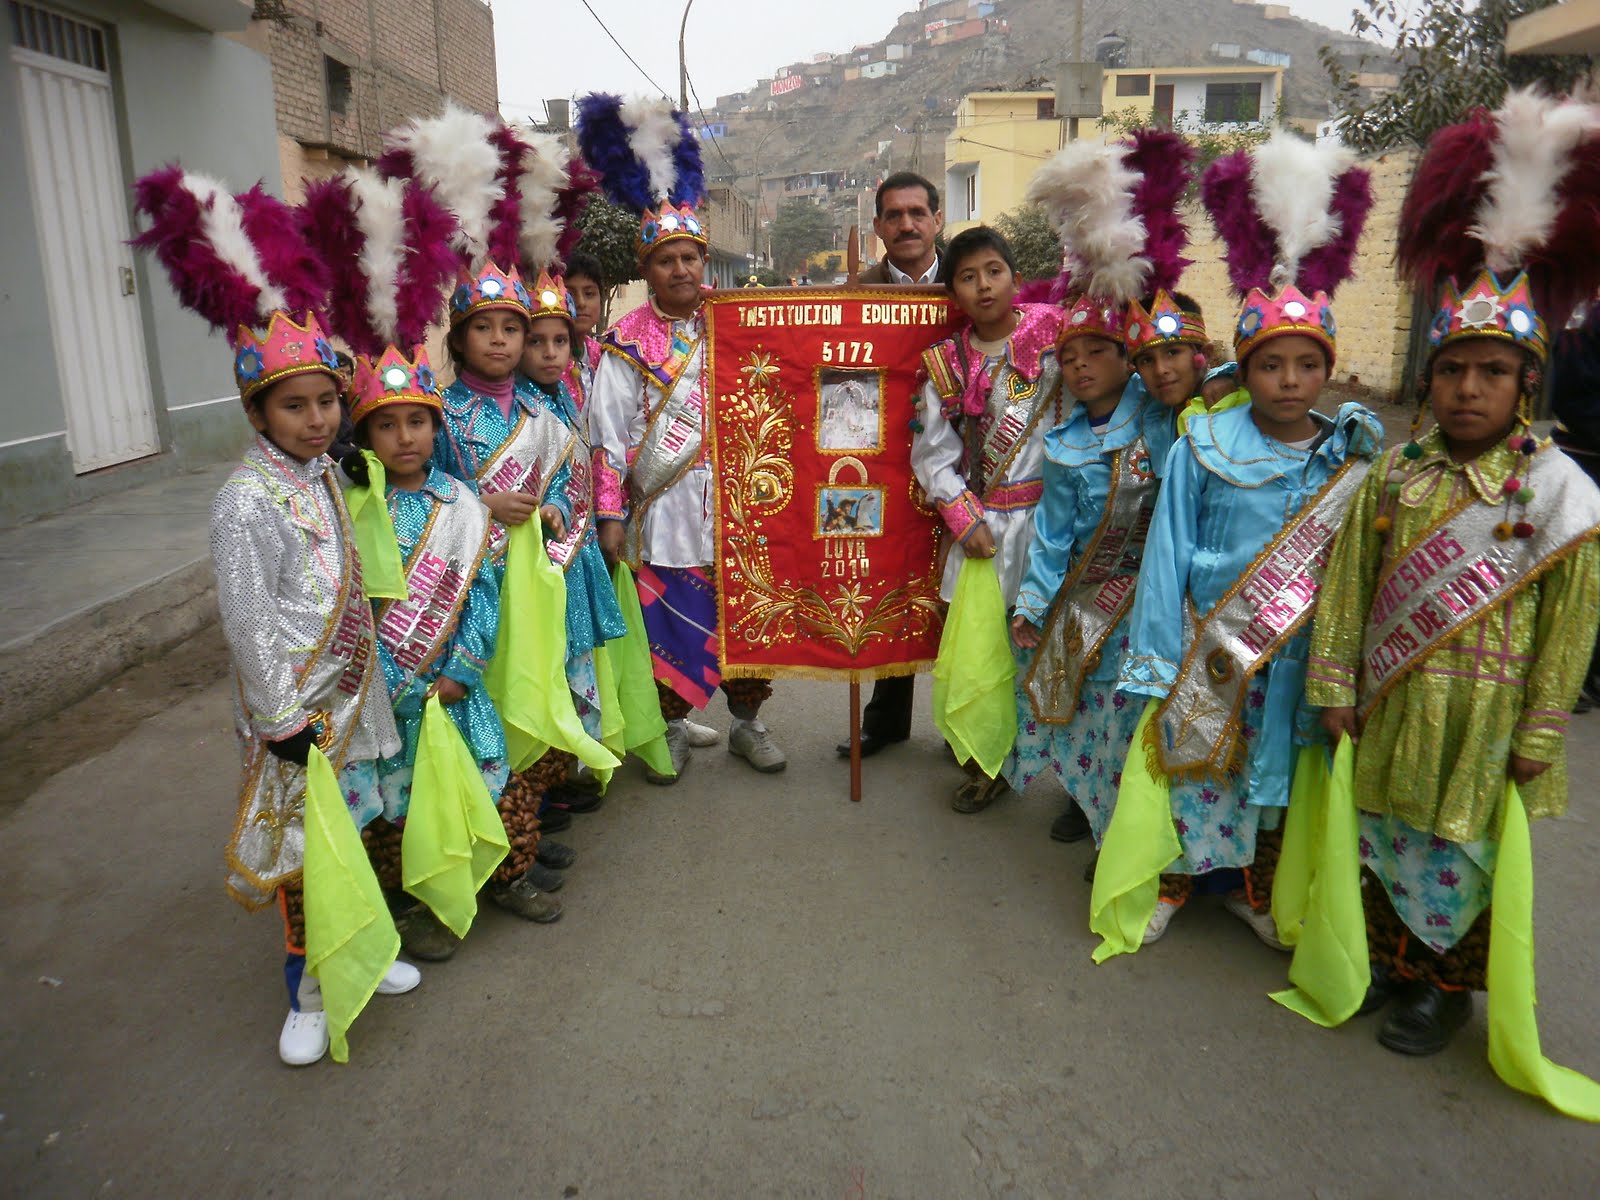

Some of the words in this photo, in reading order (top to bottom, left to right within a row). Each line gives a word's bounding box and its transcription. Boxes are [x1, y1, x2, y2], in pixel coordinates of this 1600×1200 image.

[738, 304, 842, 327] INSTITUCION
[861, 303, 948, 325] EDUCATIVA
[822, 341, 874, 364] 5172
[825, 538, 866, 559] LUYA
[821, 558, 870, 579] 2010
[416, 611, 443, 641] DE
[430, 567, 465, 612] LUYA
[1368, 623, 1420, 682] HIJOS
[1409, 601, 1448, 640] DE
[1437, 559, 1506, 616] LUYA
